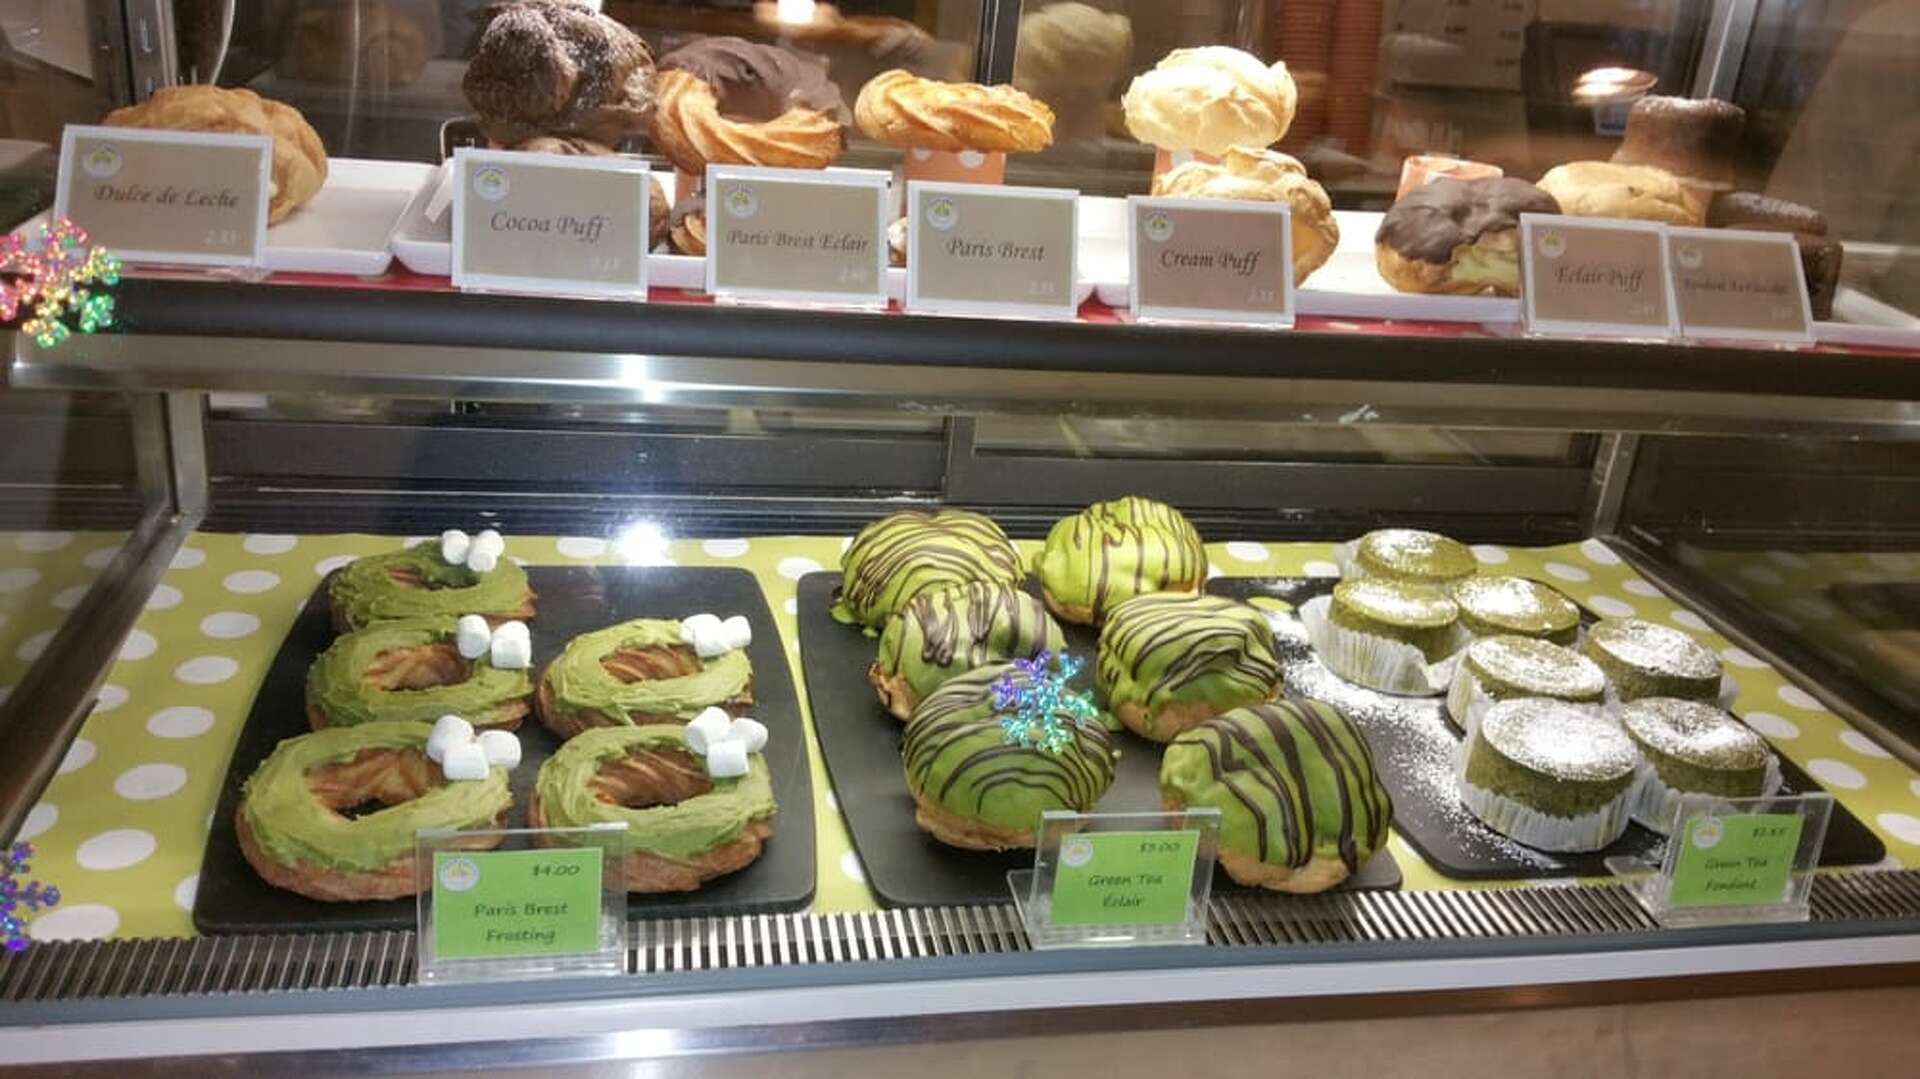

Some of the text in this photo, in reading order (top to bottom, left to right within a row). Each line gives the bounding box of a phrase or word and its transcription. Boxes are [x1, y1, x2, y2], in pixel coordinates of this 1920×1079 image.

[157, 187, 177, 204] de
[491, 211, 608, 243] Cocoa Puff
[728, 229, 769, 247] Paris
[775, 231, 815, 248] Brest
[947, 239, 1046, 262] Paris Brest
[1161, 249, 1263, 277] Cream Puff
[532, 864, 580, 877] $4.00
[1088, 873, 1164, 887] Green Tea
[474, 902, 568, 917] Paris Brest
[486, 927, 556, 945] Frosting
